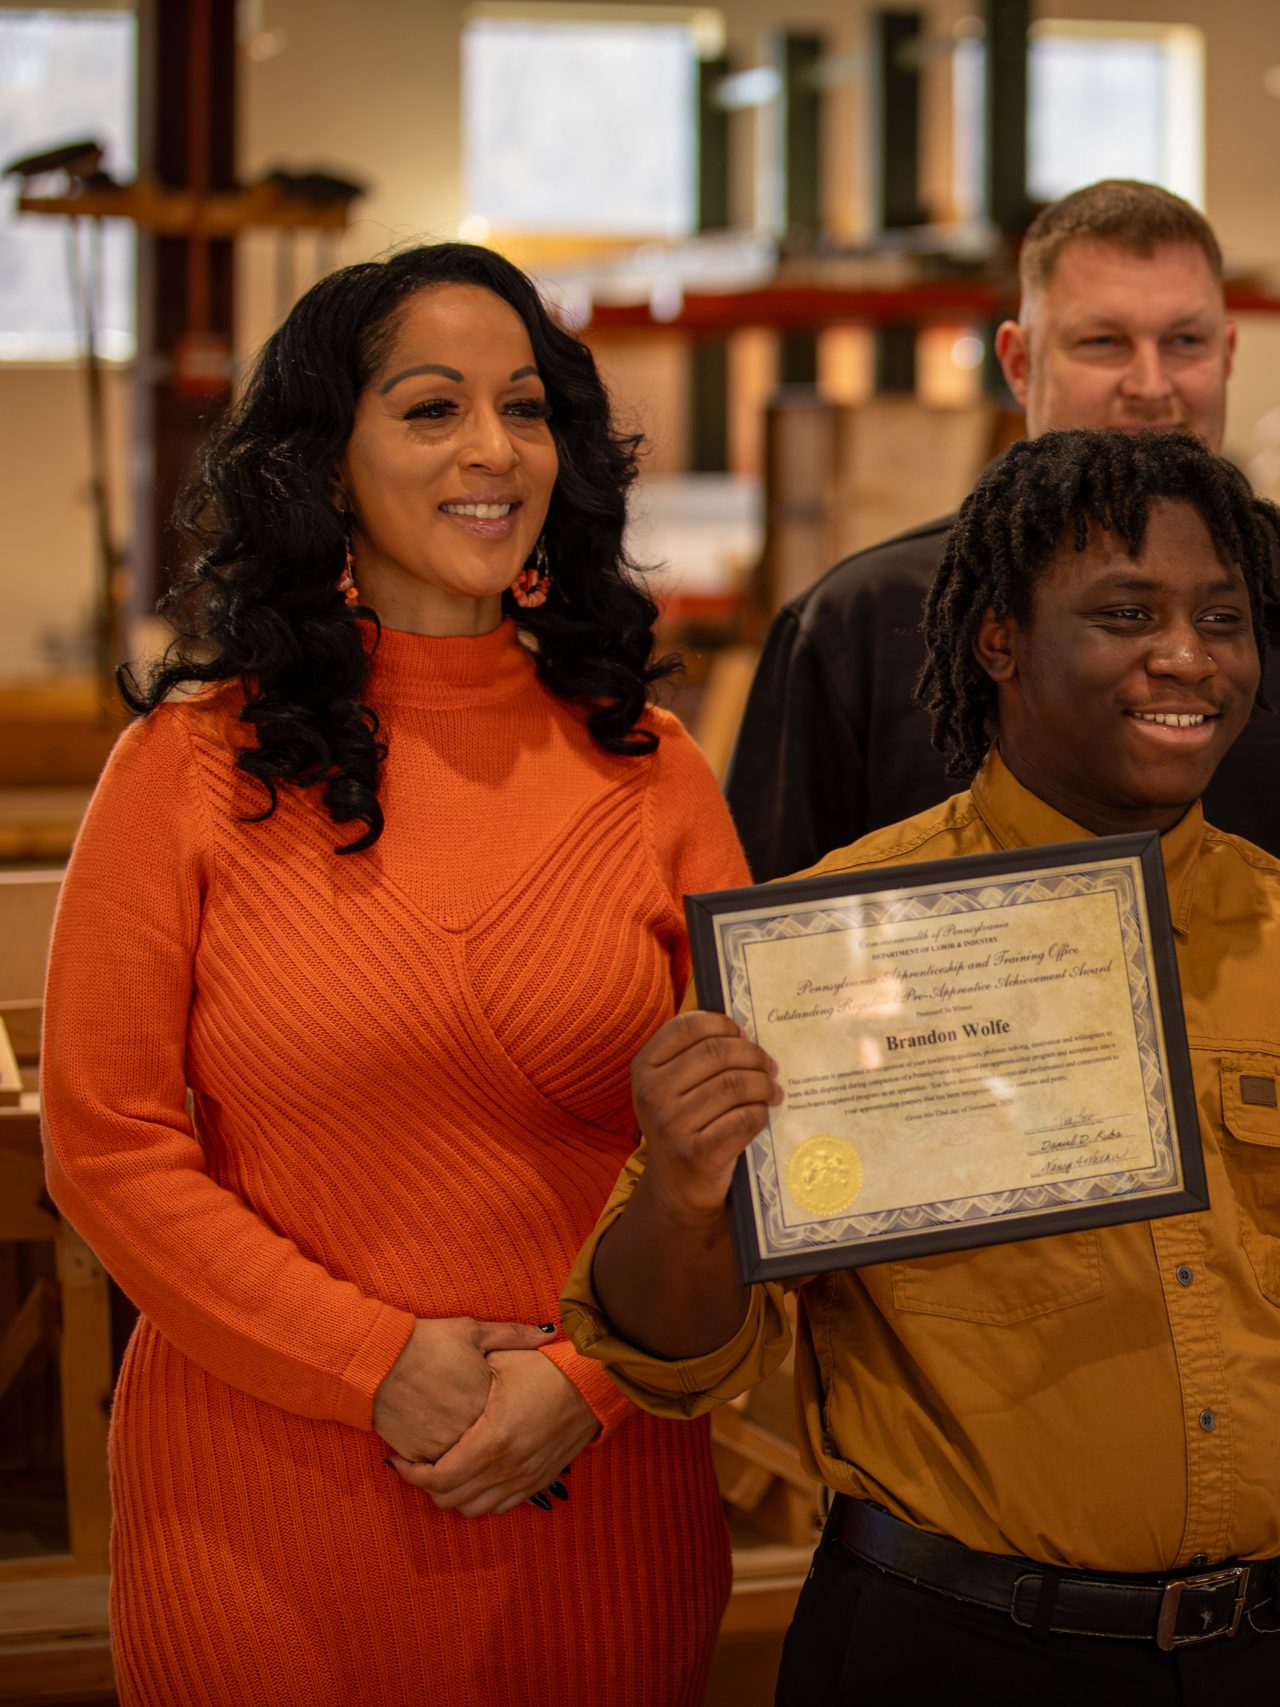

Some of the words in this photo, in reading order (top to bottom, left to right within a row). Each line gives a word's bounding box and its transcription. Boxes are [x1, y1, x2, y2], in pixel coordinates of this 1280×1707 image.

[857, 929, 928, 949] Commonwealth
[931, 927, 945, 943] of
[943, 922, 1009, 937] Pennsylvania
[872, 948, 919, 961] DEPARTMENT
[931, 943, 955, 952] LABOR
[963, 937, 998, 947] INDUSTRY
[797, 977, 877, 996] Pennsylvania
[885, 961, 964, 981] Apprenticeship
[967, 955, 991, 970] and
[994, 950, 1045, 966] Training
[1048, 943, 1079, 962] Office
[768, 1005, 834, 1023] Outstanding
[902, 983, 991, 1003] Pre-Apprentice
[995, 969, 1067, 988] Achievement
[1069, 961, 1112, 978] Award
[886, 1030, 957, 1051] Brandon
[962, 1020, 1010, 1038] Wolfe
[912, 1070, 950, 1079] Pennsylvania
[905, 1114, 923, 1122] Given
